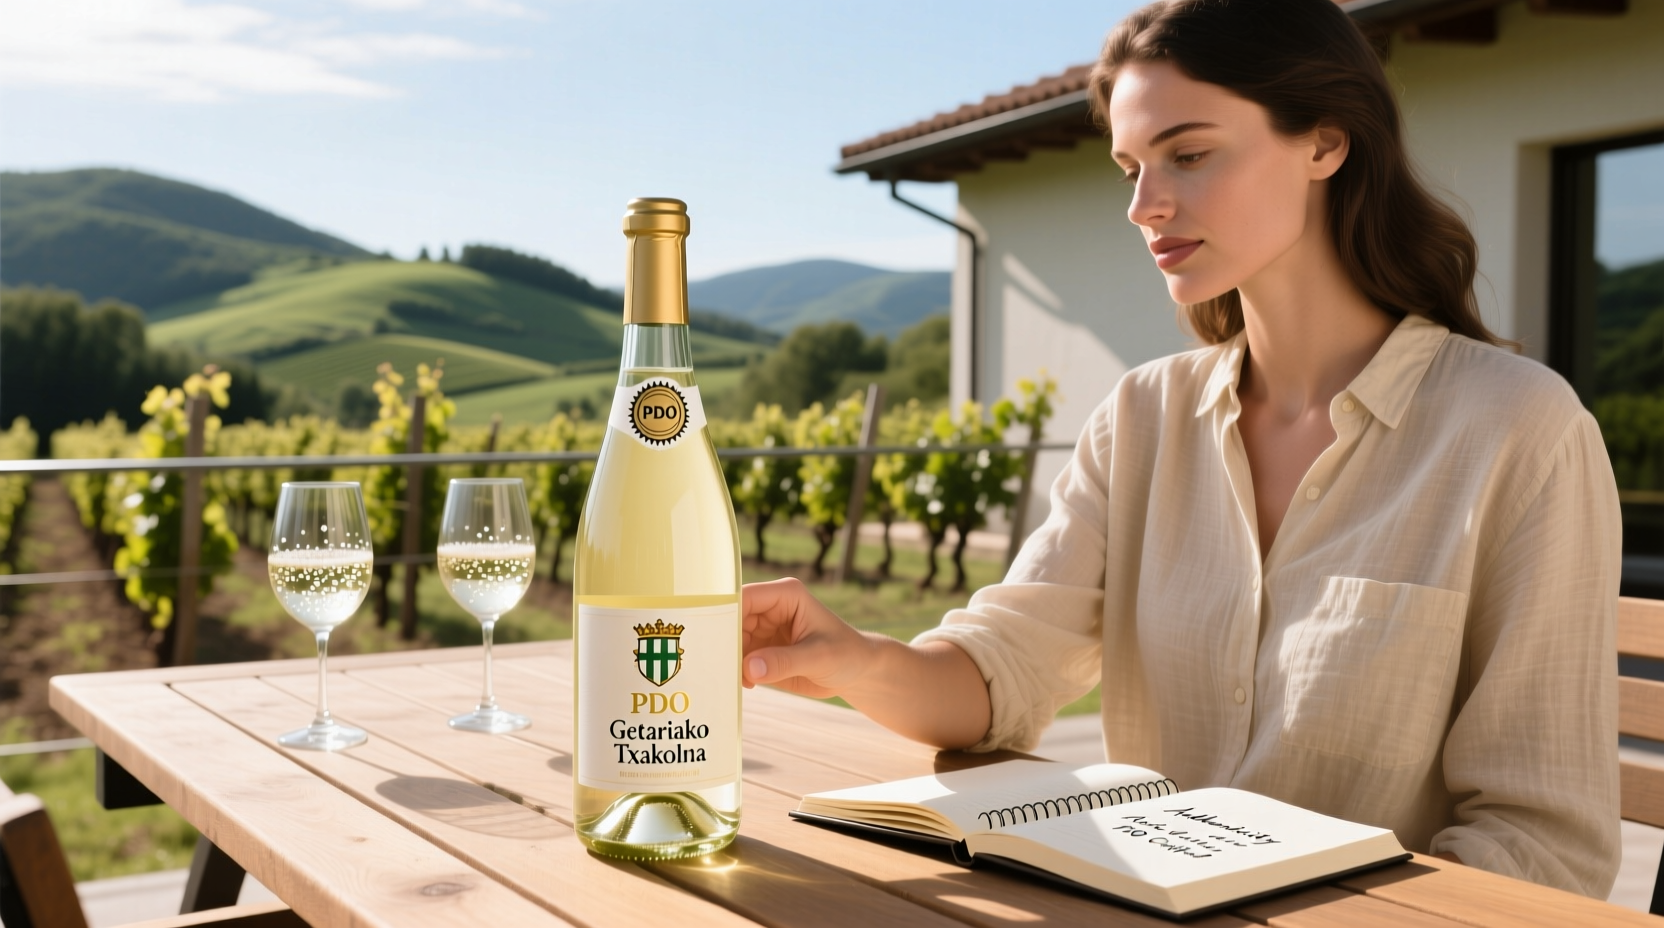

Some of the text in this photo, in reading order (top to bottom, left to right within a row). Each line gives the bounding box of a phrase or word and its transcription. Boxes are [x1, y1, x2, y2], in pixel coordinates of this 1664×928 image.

[643, 405, 677, 420] PDO
[630, 691, 690, 714] PDO
[609, 718, 710, 740] Getariako
[613, 743, 707, 765] Txakolna
